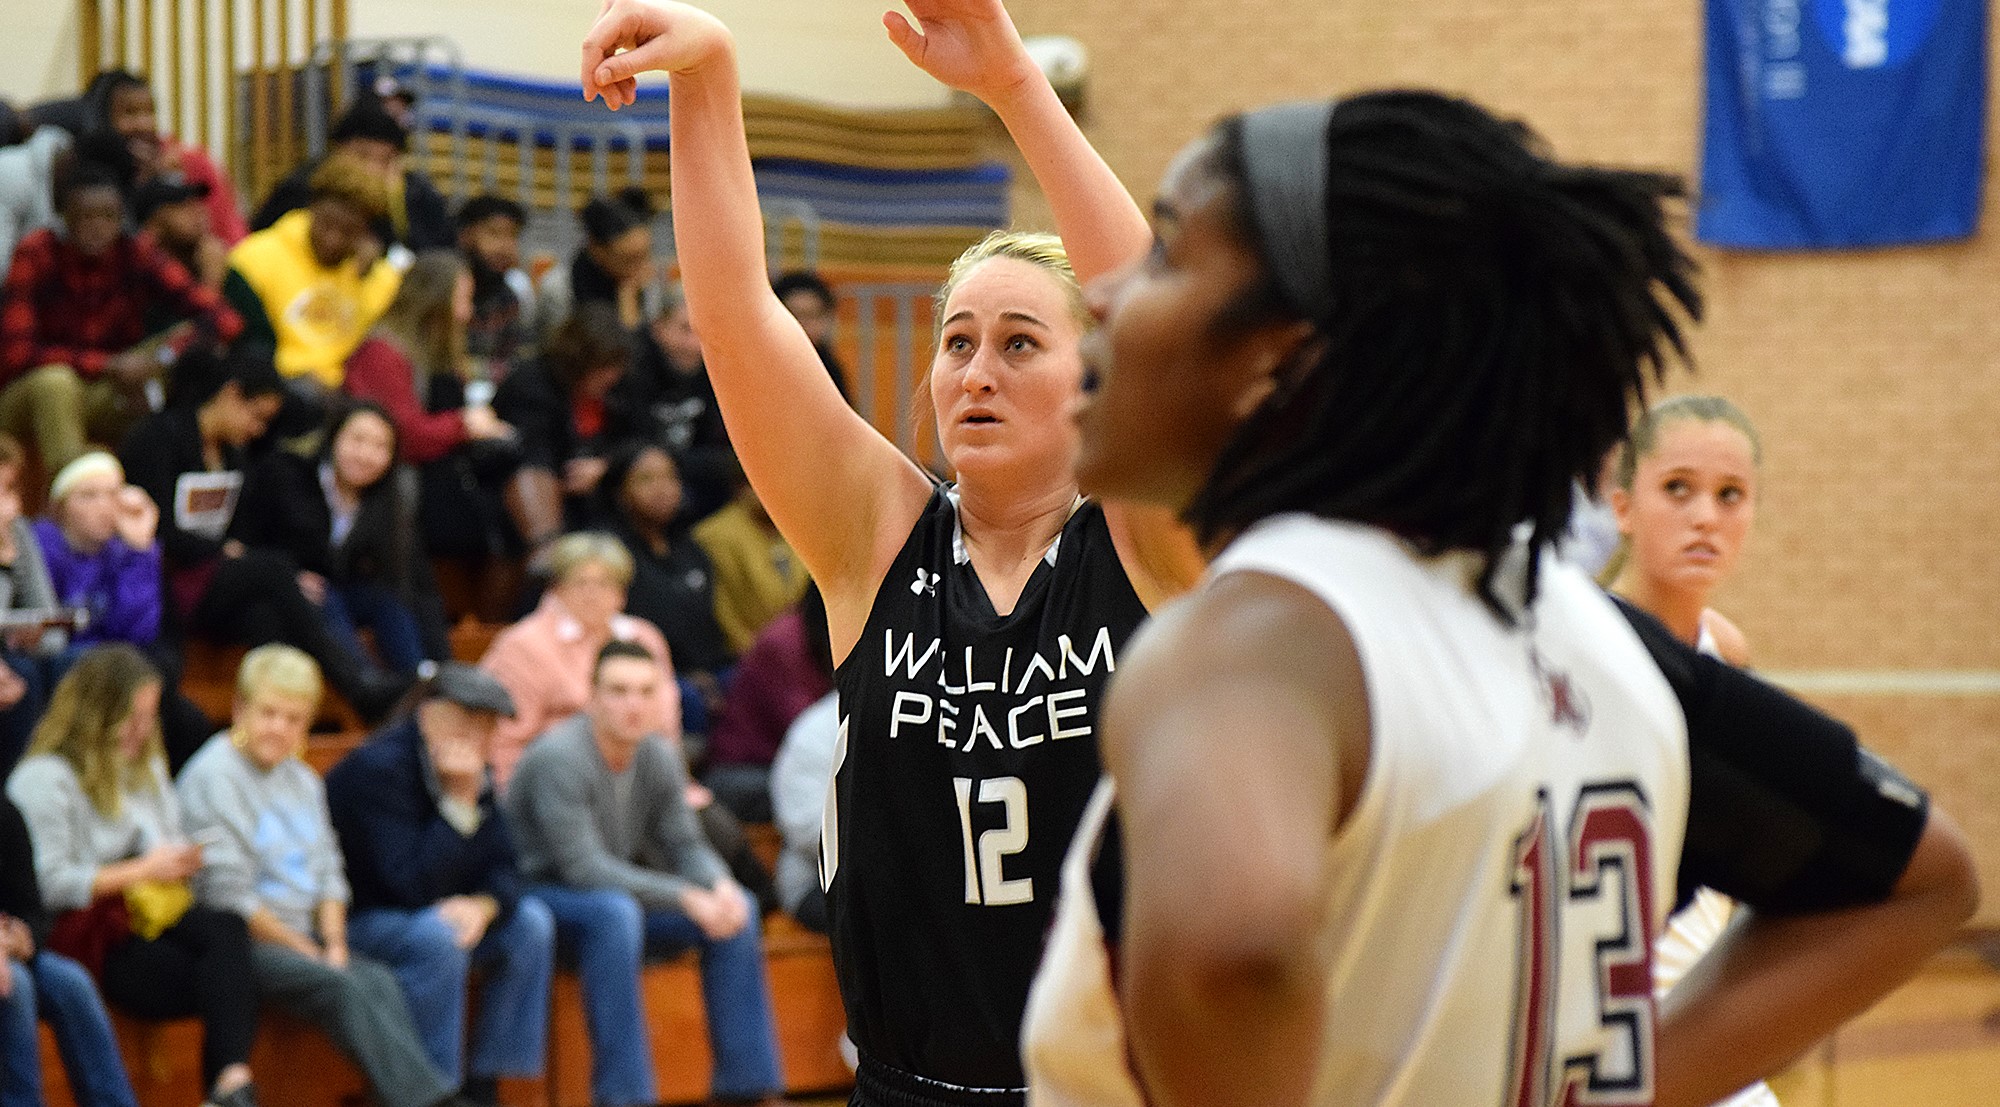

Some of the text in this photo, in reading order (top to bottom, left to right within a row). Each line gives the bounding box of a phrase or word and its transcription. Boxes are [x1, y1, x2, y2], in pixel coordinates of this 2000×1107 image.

[885, 626, 1116, 695] WLLIAM
[889, 688, 1092, 752] PEACE
[952, 776, 1034, 906] 12
[1502, 779, 1656, 1107] 13
